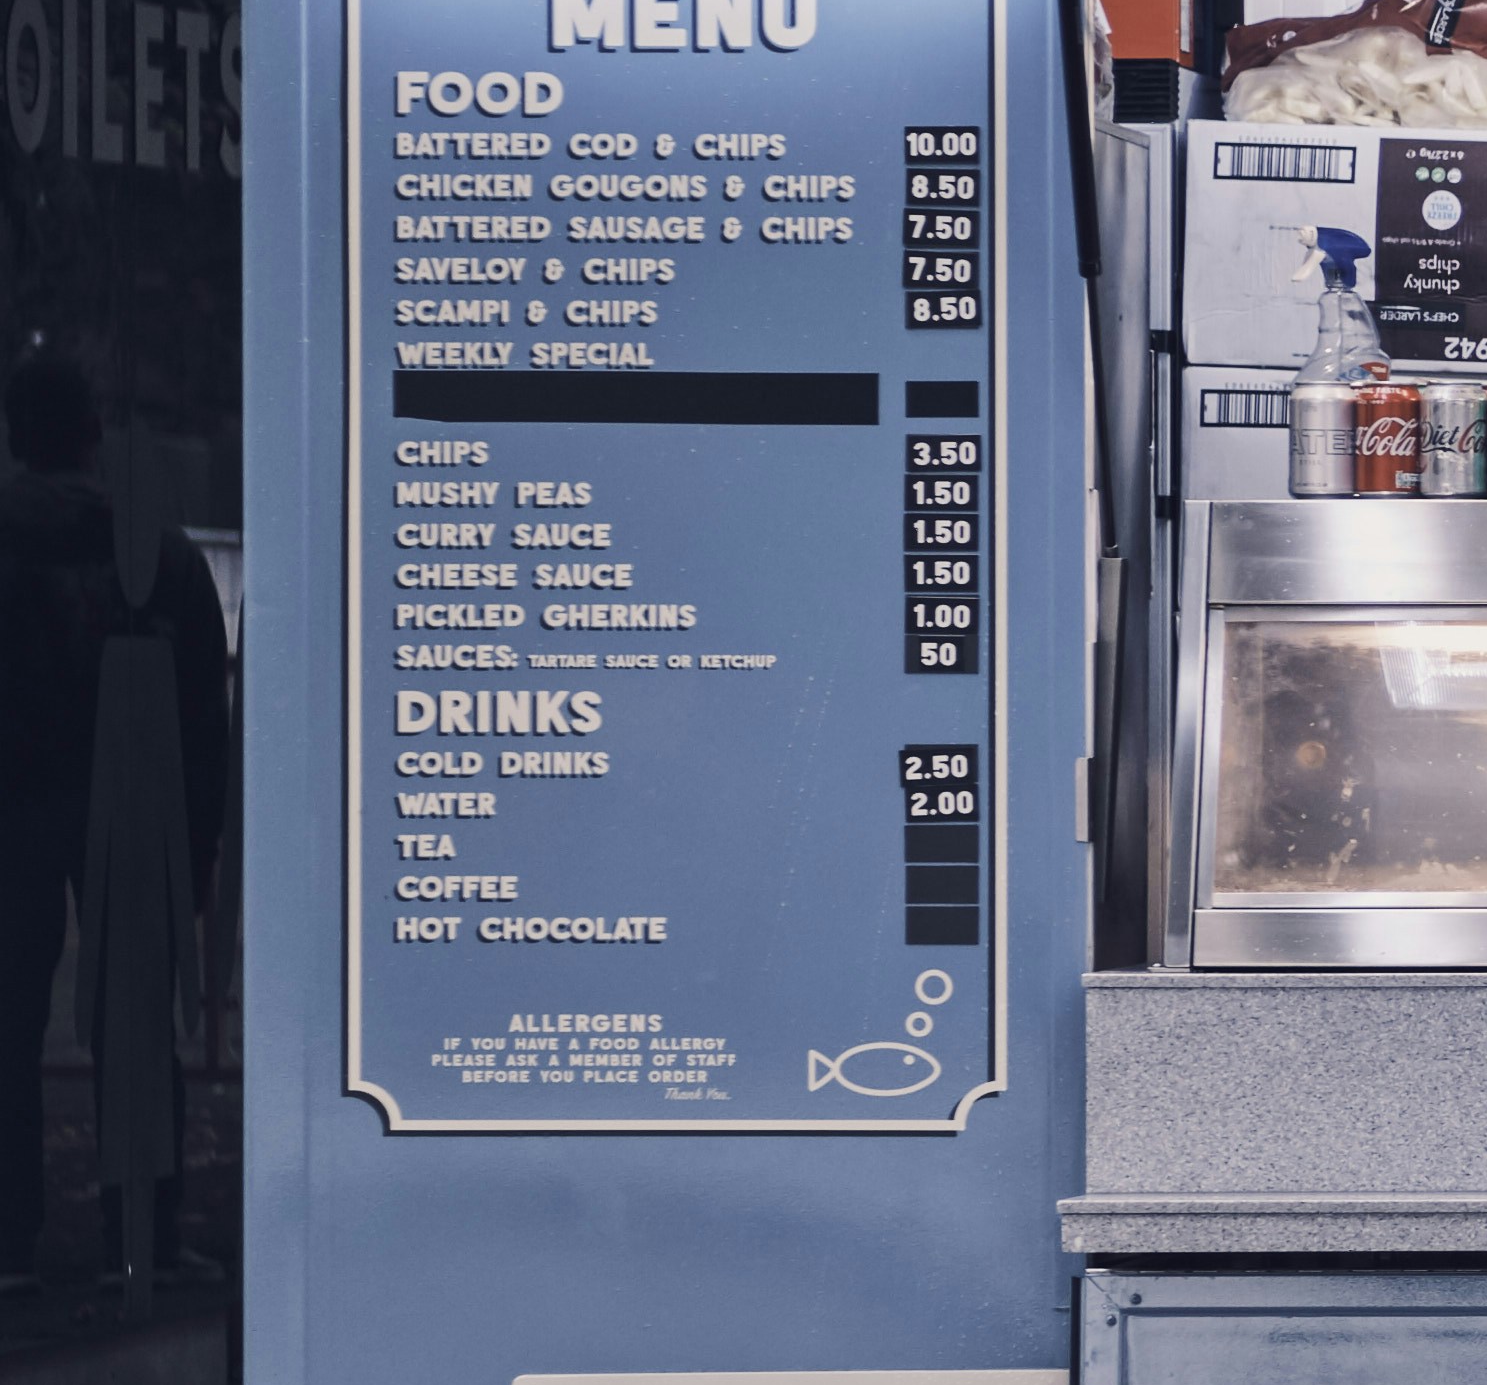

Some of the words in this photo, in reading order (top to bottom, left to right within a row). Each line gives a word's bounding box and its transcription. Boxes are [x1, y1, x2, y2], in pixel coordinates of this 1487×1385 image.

[397, 70, 564, 114] FOOD
[396, 132, 552, 156] BATTERED
[569, 132, 639, 157] COD
[656, 133, 677, 157] &
[694, 133, 787, 157] CHIPS
[906, 132, 977, 157] 10.00
[396, 173, 533, 198] CHICKEN
[550, 174, 708, 198] GOUGONS
[725, 174, 746, 198] &
[764, 174, 856, 199] CHIPS
[911, 174, 975, 200] 8.50
[396, 215, 552, 239] BATTERED
[569, 216, 706, 240] SAUSAGE
[723, 216, 743, 240] &
[762, 216, 854, 240] CHIPS
[908, 214, 972, 241] 7.50
[397, 257, 527, 281] SAVELOY
[545, 257, 565, 281] &
[583, 257, 676, 282] CHIPS
[908, 256, 972, 283] 7.50
[1418, 257, 1461, 275] chips
[1403, 274, 1461, 295] chunky
[397, 299, 510, 323] SCAMPI
[527, 299, 548, 323] &
[566, 299, 658, 323] CHIPS
[913, 296, 977, 322] 8.50
[1379, 310, 1421, 323] LARDER
[1423, 311, 1460, 323] CHEF'S
[397, 690, 603, 733] DRINKS
[397, 751, 484, 775] COLD
[501, 751, 610, 775] DRINKS
[904, 754, 968, 781] 2.50
[397, 792, 496, 816] WATER
